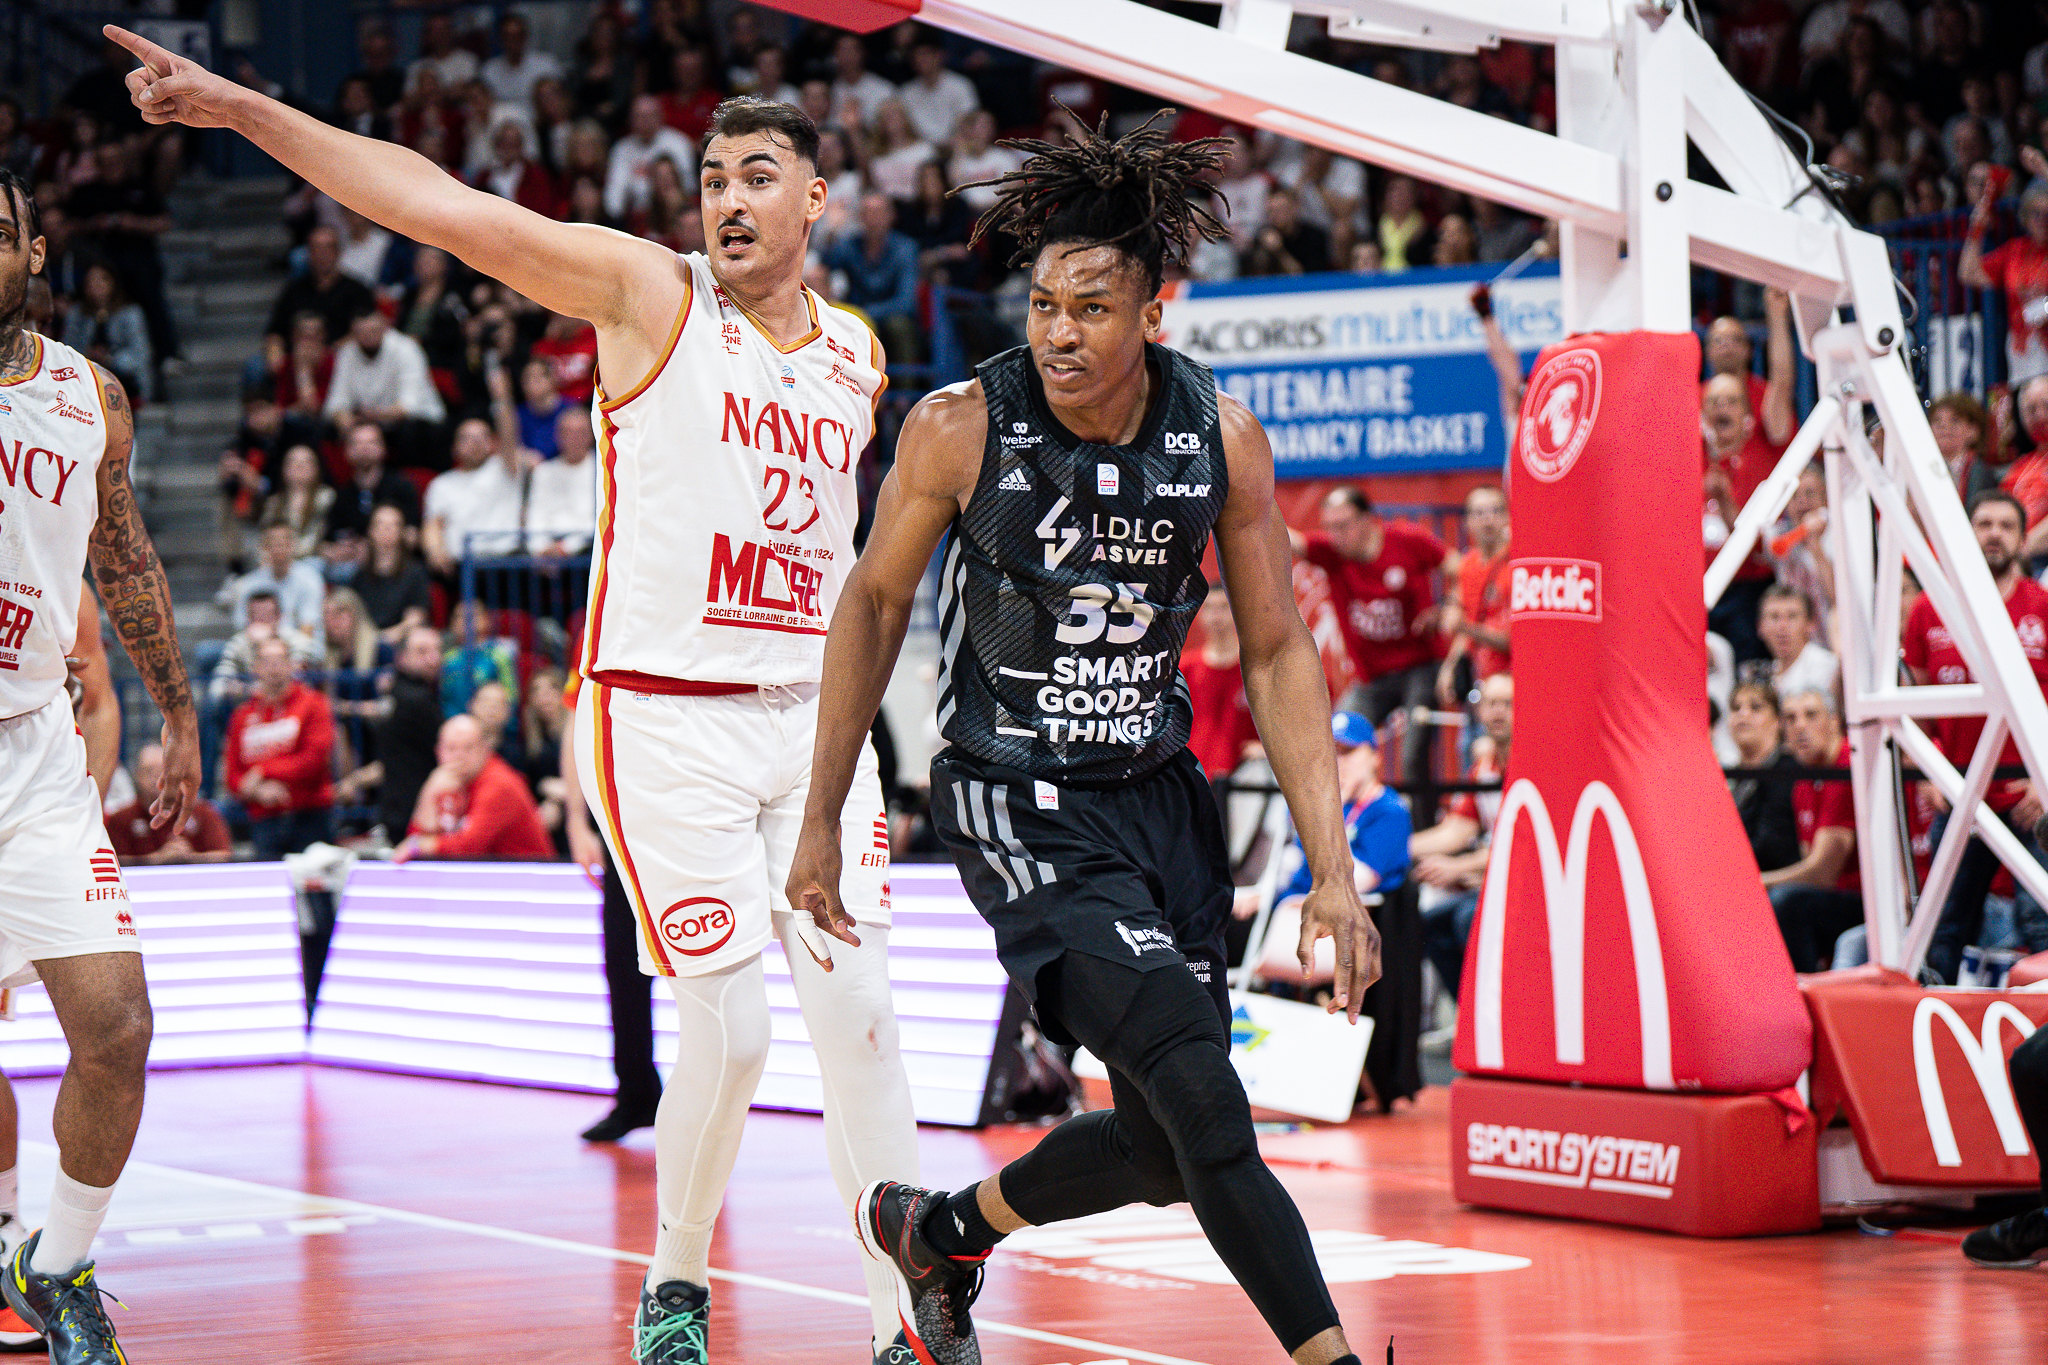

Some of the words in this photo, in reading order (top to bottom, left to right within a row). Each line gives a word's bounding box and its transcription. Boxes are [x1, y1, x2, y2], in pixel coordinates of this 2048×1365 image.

[1184, 315, 1326, 352] ACORIS
[721, 391, 854, 474] NANCY
[1000, 434, 1043, 445] webex
[1165, 432, 1201, 449] DCB
[1365, 411, 1489, 460] BASKET
[998, 475, 1032, 491] adidas
[1156, 484, 1212, 497] OLPLAY
[1092, 513, 1175, 543] LDLC
[814, 548, 834, 562] 1924
[1090, 543, 1168, 565] ASVEL
[13, 582, 43, 599] 1924
[1512, 565, 1595, 613] Betclic
[706, 606, 742, 619] SOCIÉTÉ
[744, 610, 785, 624] LORRAINE
[787, 616, 798, 626] DE
[1055, 582, 1154, 645] 35
[1052, 650, 1169, 686] SMART
[1042, 709, 1156, 745] THINGS
[664, 908, 731, 941] cora
